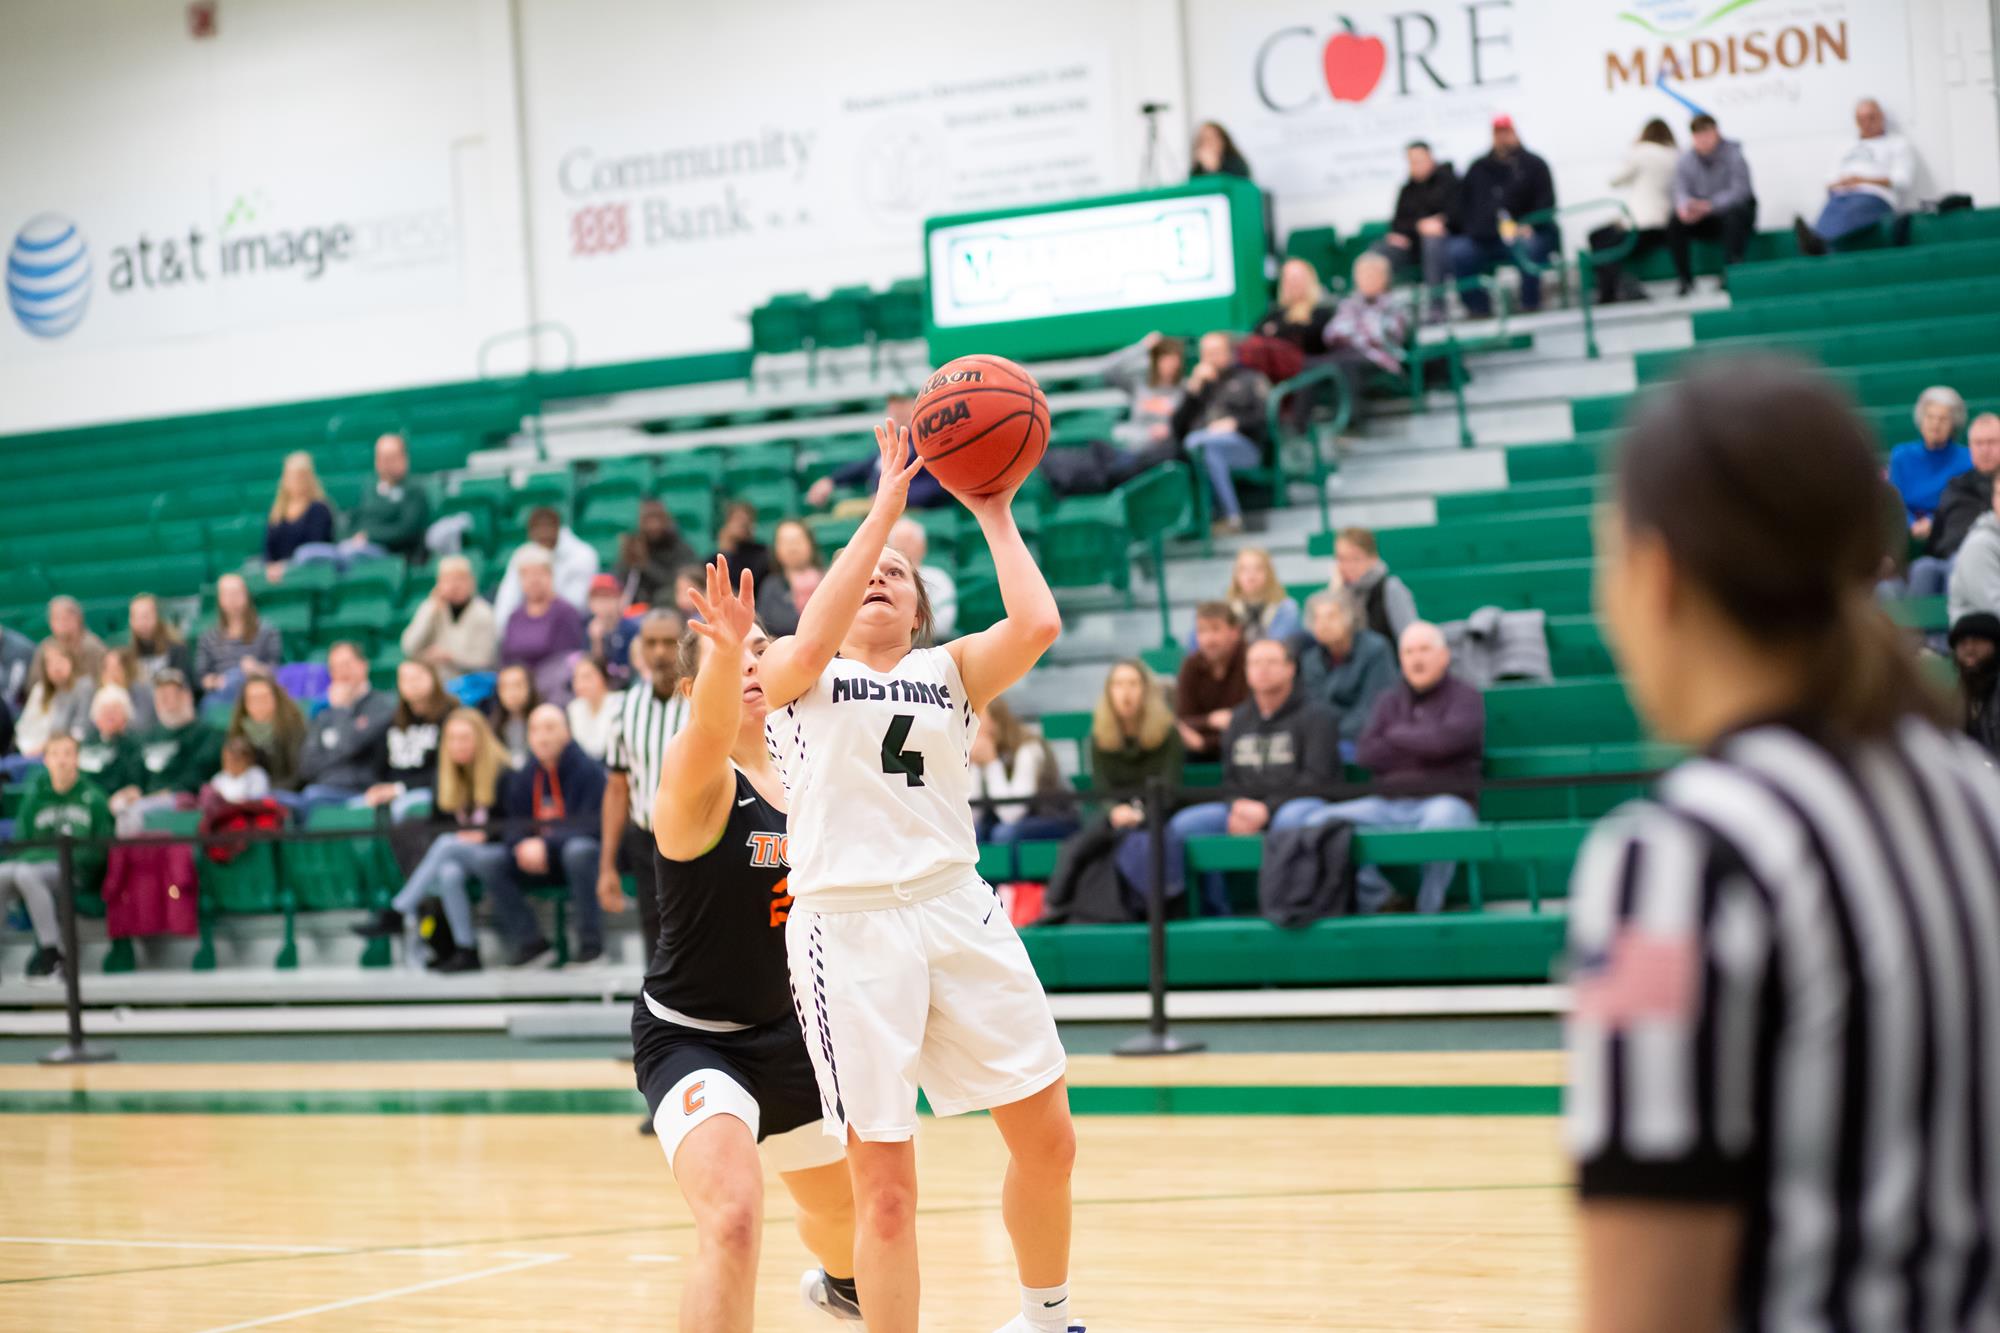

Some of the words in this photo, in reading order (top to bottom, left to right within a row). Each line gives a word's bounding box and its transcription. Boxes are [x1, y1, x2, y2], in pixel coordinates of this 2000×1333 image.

[1604, 21, 1850, 92] MADISON
[557, 126, 818, 198] Community
[641, 182, 753, 248] Bank
[108, 222, 207, 293] at&t
[917, 399, 971, 443] NCAA
[881, 714, 925, 787] 4
[682, 1080, 705, 1116] C
